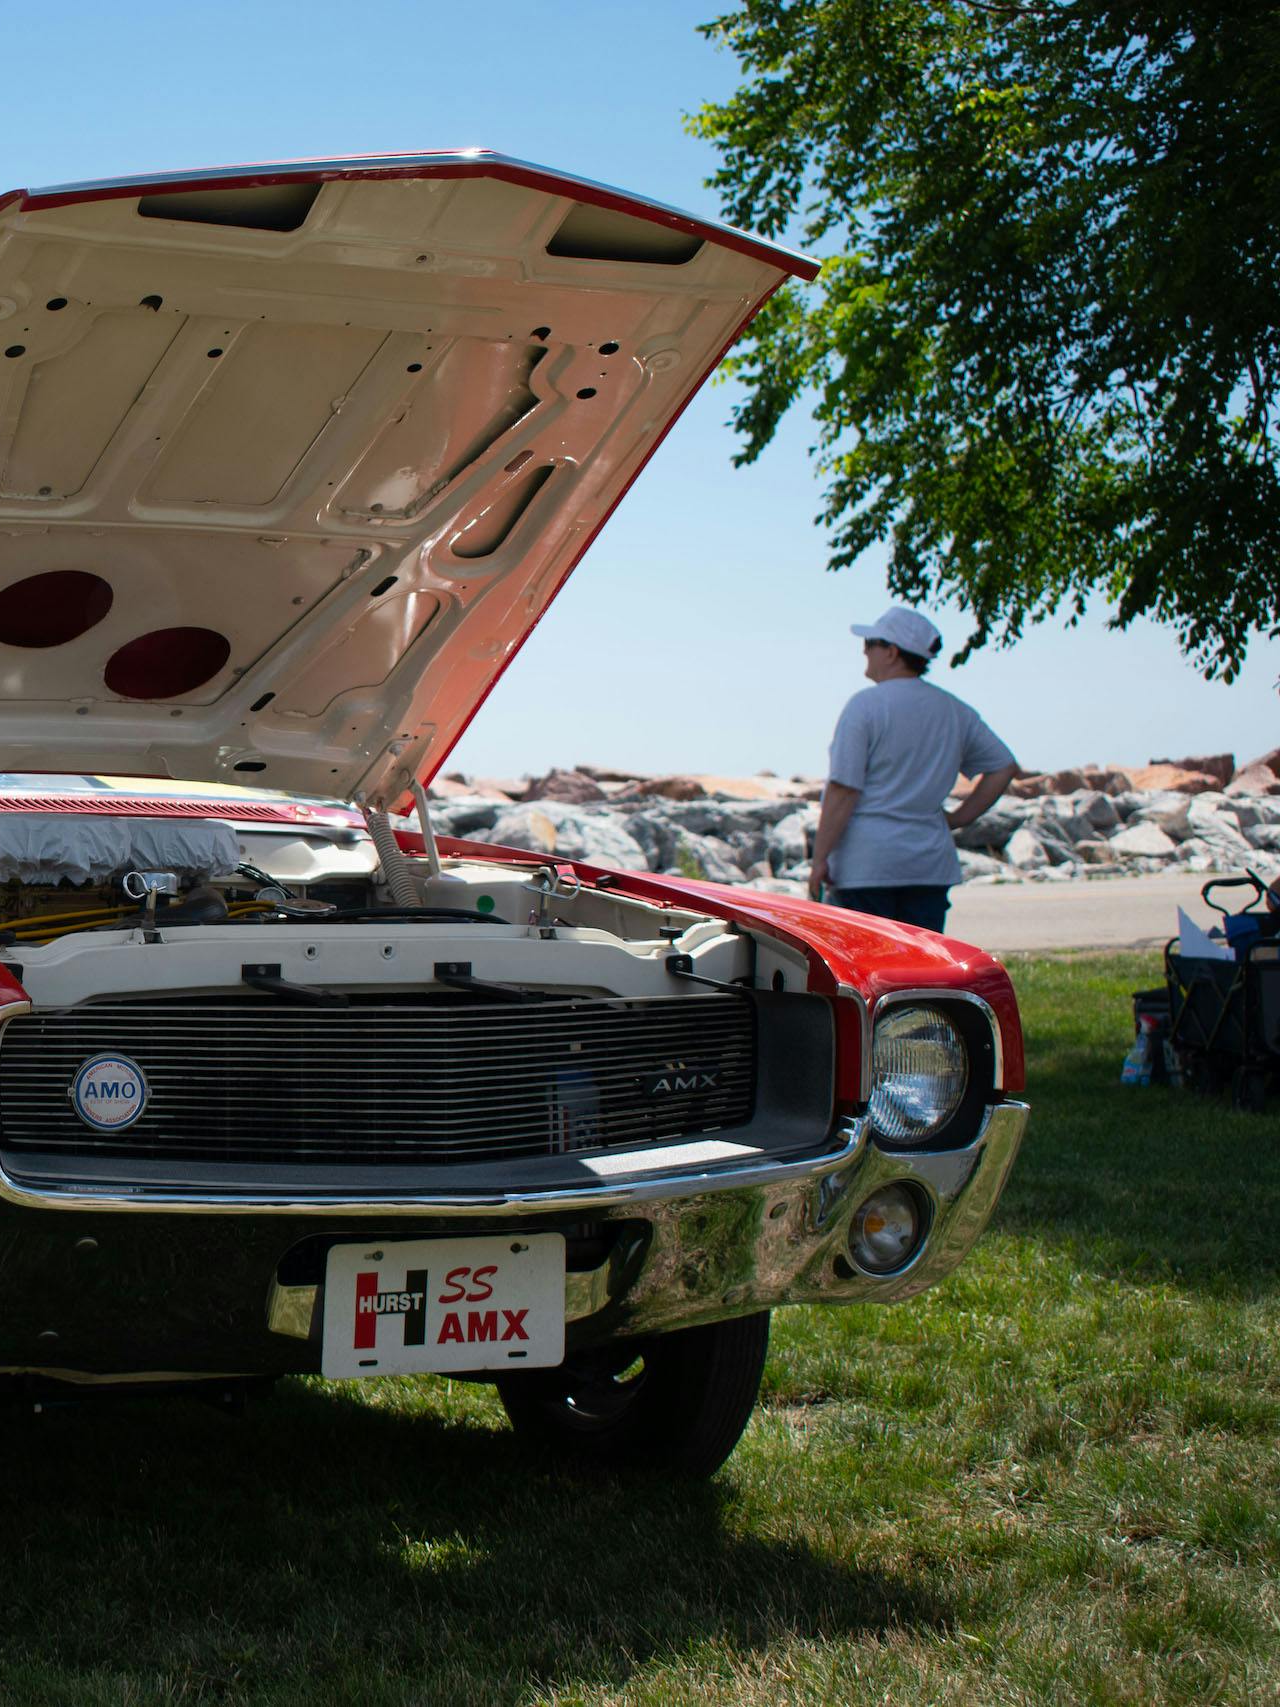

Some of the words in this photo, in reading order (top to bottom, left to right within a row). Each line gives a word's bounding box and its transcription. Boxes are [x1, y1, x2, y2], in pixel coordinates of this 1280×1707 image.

[84, 1081, 136, 1099] AMO
[652, 1073, 719, 1093] AMX
[438, 1265, 498, 1304] SS
[359, 1291, 424, 1315] HURST
[437, 1309, 530, 1345] AMX
